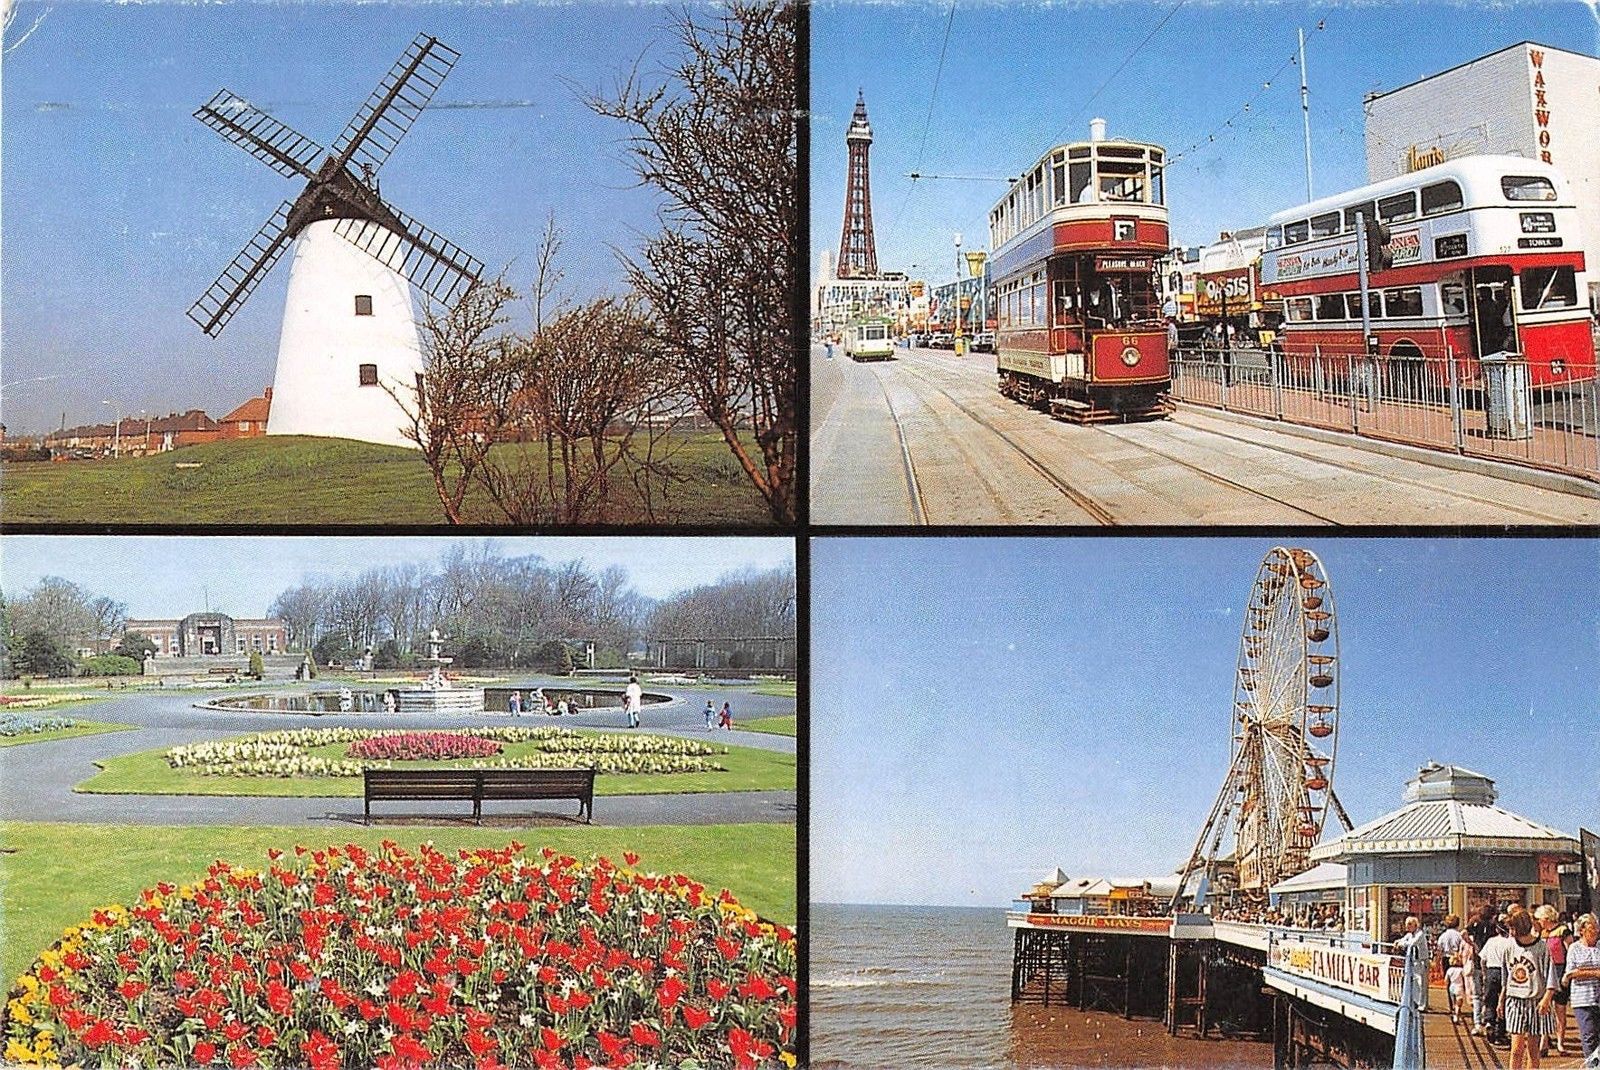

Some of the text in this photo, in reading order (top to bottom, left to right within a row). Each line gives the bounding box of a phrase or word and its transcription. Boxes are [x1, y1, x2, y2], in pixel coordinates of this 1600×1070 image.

[1114, 220, 1135, 241] F
[1206, 276, 1249, 301] OASIS
[1122, 336, 1138, 346] 66
[1051, 915, 1098, 926] MAGGIE
[1103, 918, 1141, 928] MAYS
[1313, 950, 1357, 986] FAMILY
[1359, 963, 1380, 988] BAR
